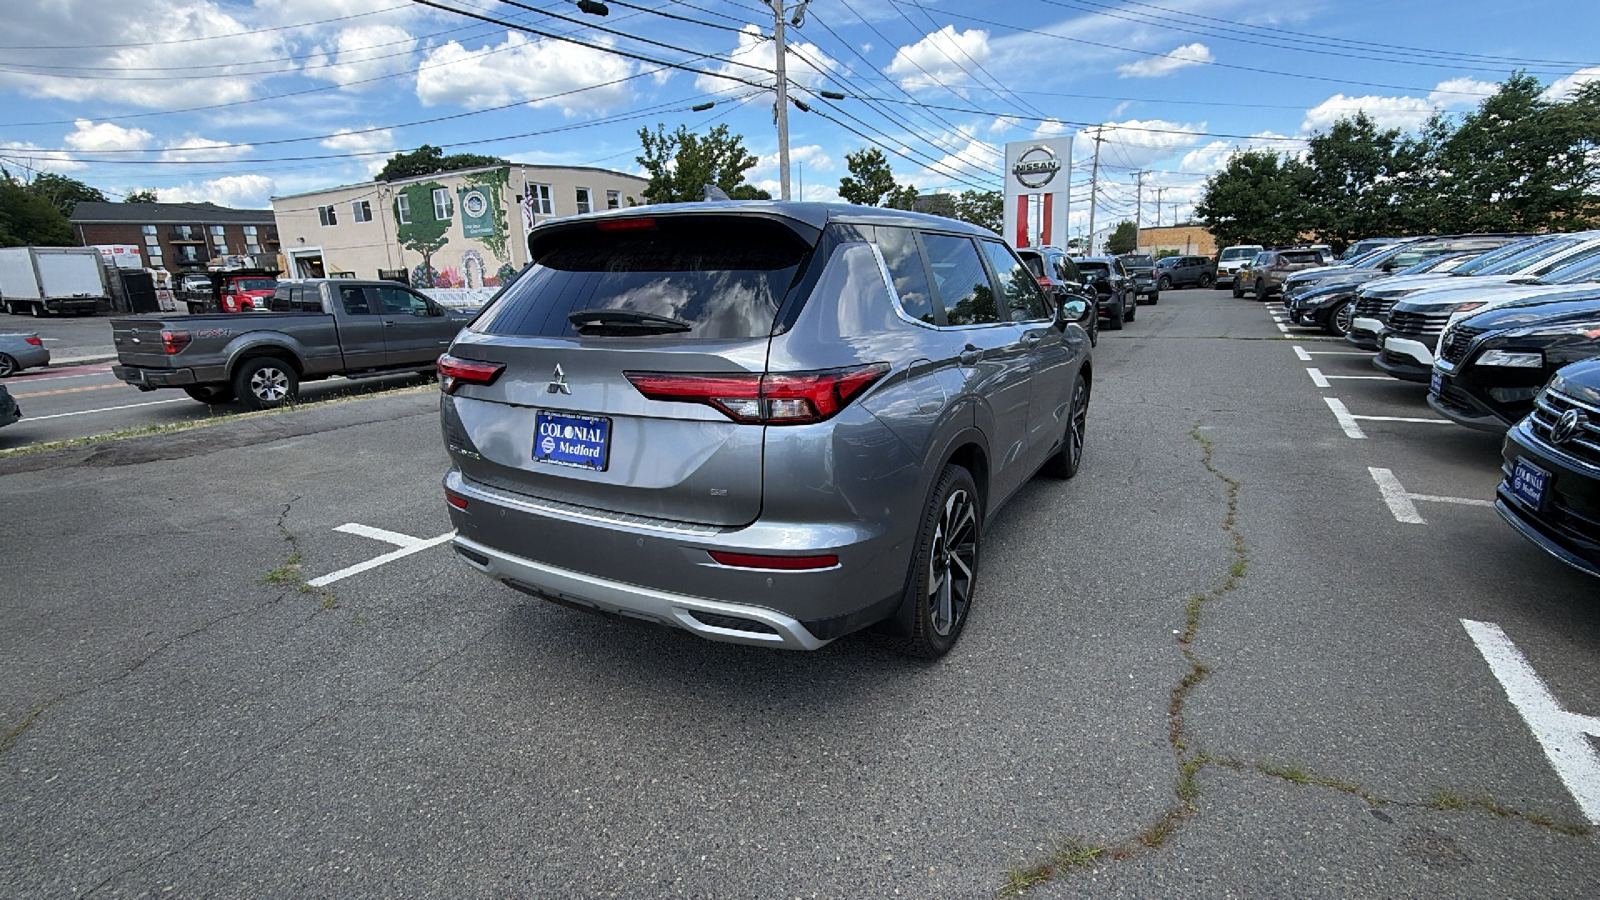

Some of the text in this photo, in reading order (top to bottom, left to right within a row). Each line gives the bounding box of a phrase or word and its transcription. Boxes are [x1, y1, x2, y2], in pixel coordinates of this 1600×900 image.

[1016, 161, 1056, 171] NISSAN
[540, 422, 604, 443] COLONIAL
[559, 441, 600, 458] Medford
